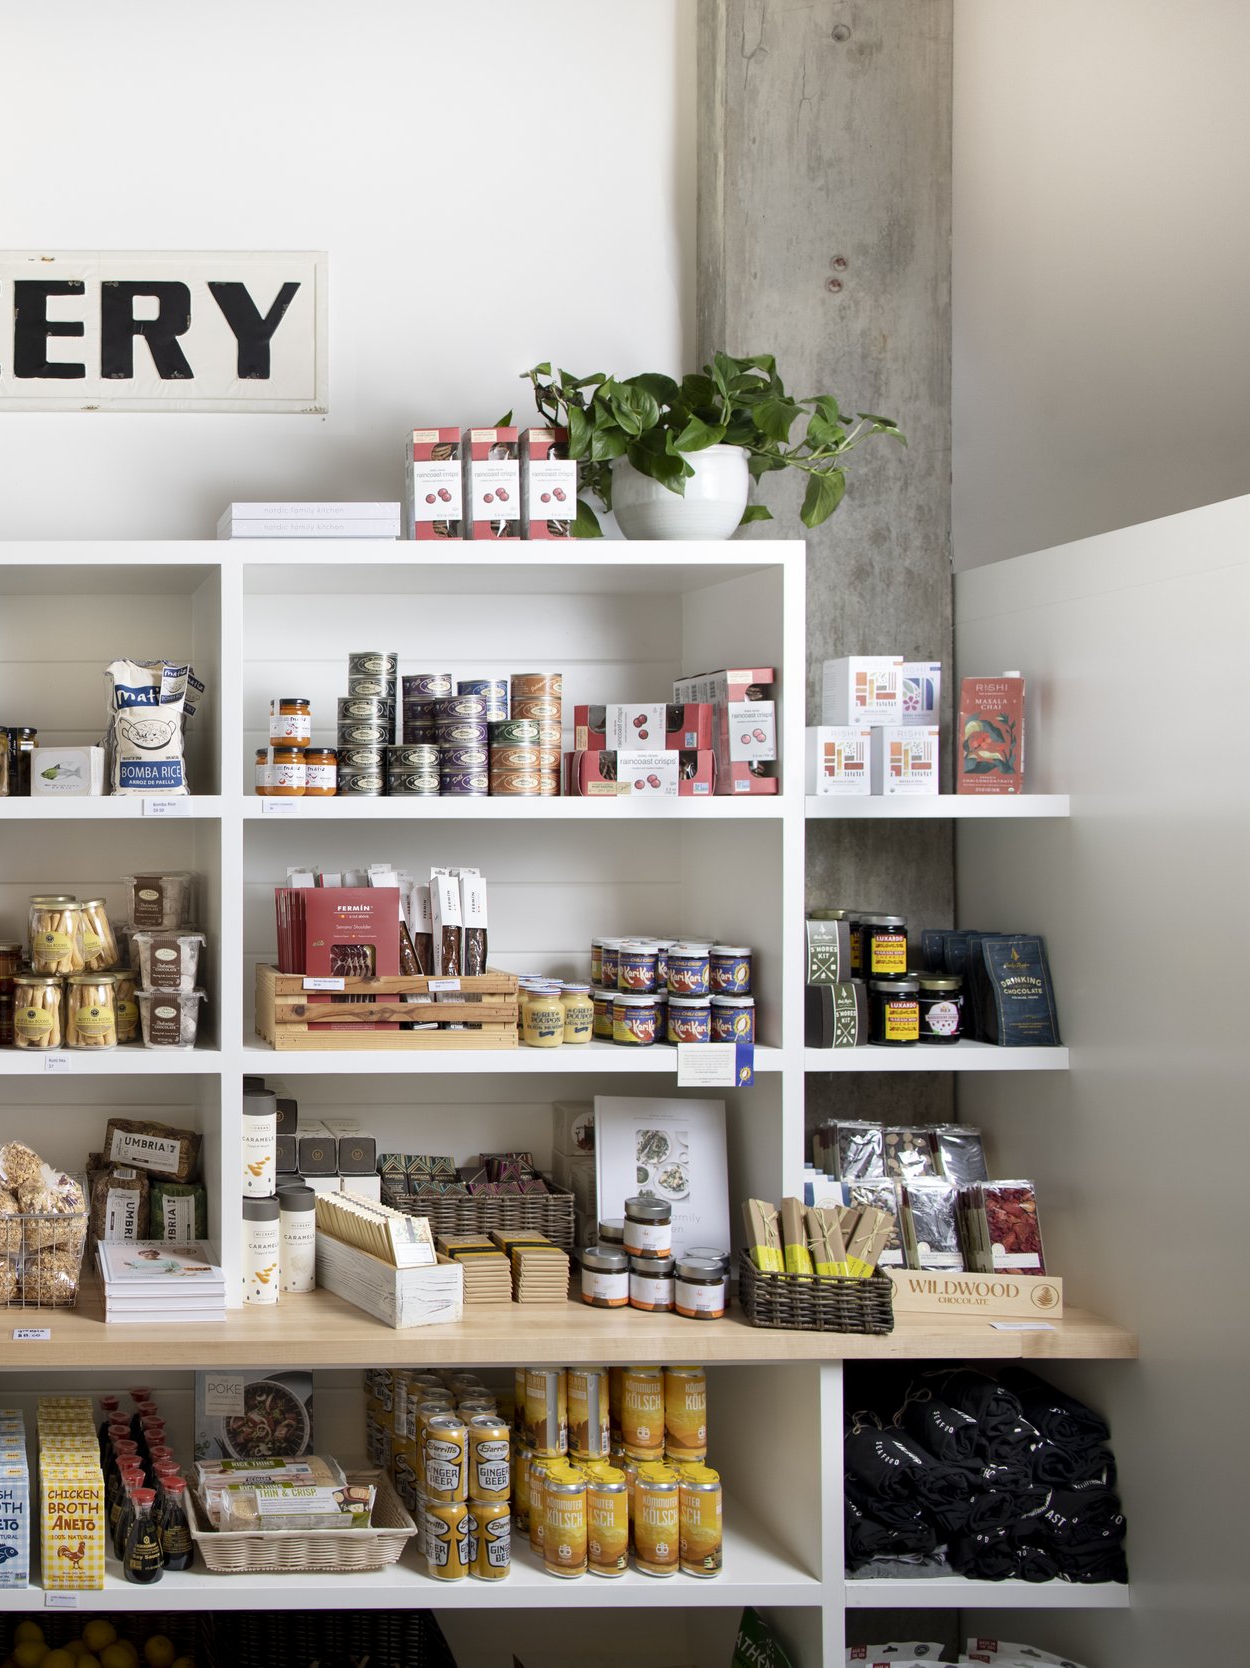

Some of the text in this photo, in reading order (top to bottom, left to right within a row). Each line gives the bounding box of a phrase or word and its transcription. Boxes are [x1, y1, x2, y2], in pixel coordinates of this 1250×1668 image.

[291, 507, 314, 515] family
[291, 524, 314, 532] family
[976, 684, 1008, 692] RISHI
[831, 730, 857, 738] RISHI
[897, 730, 924, 738] RISHI
[620, 757, 676, 766] raincoast crisps
[122, 766, 182, 778] BOMBA RICE
[337, 903, 370, 912] FERMÍN
[1001, 976, 1042, 987] DRINKING
[836, 1009, 857, 1017] S'MORES
[124, 1136, 166, 1152] UMBRIA
[909, 1279, 1020, 1298] WILDWOOD
[938, 1296, 990, 1306] CHOCOLATE
[207, 1383, 243, 1394] POKE
[625, 1390, 661, 1409] KÖLSCH
[875, 1441, 899, 1466] SEAFOOD
[485, 1477, 507, 1486] BEER
[47, 1489, 99, 1500] CHICKEN
[260, 1489, 278, 1498] THIN
[282, 1489, 289, 1497] &
[48, 1502, 99, 1514] BROTH
[547, 1507, 583, 1529] KÖLSCH
[51, 1515, 96, 1532] ANETO
